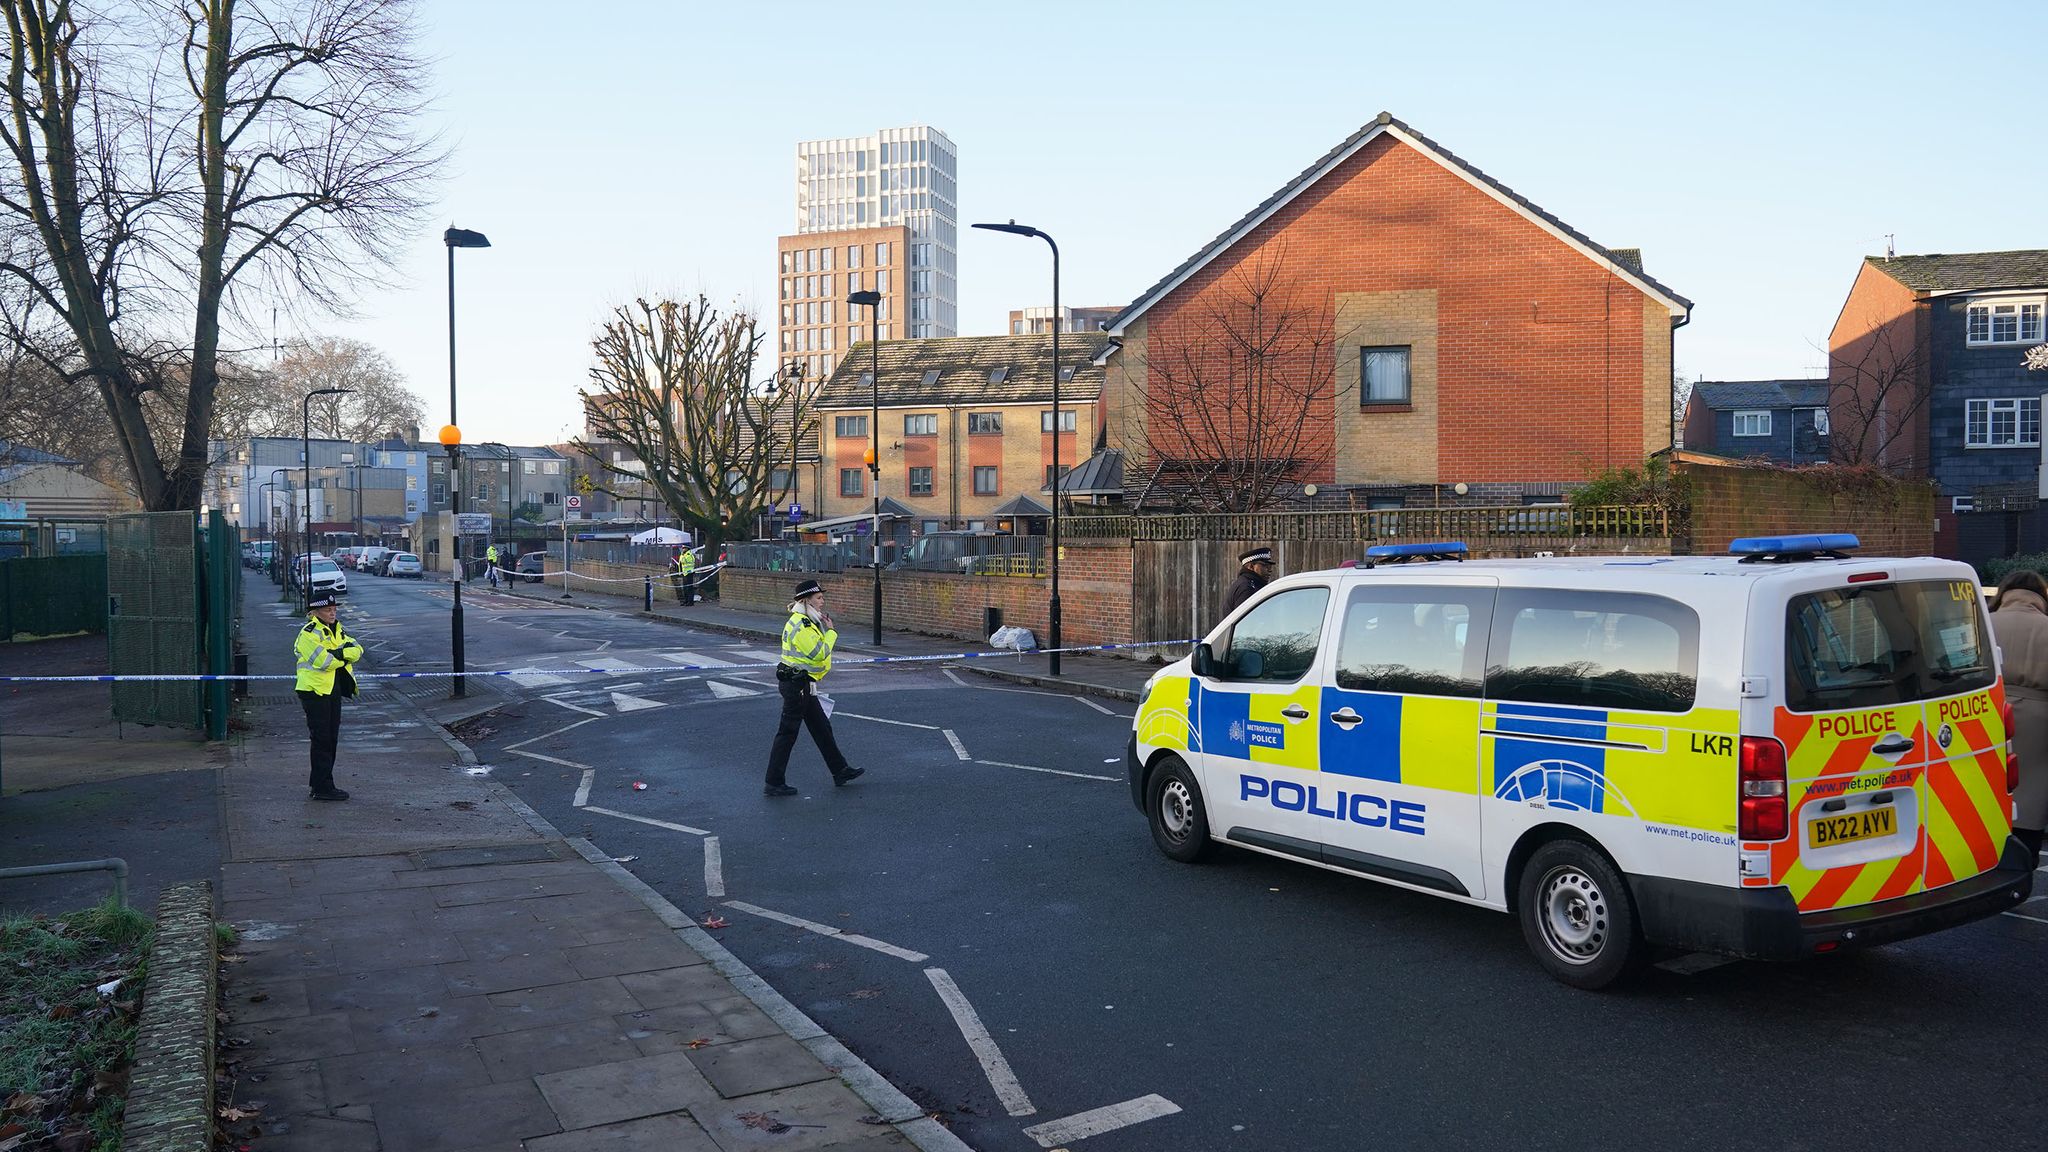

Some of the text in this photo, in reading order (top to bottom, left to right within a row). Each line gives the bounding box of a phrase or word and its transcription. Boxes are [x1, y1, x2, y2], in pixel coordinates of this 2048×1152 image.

[792, 506, 799, 515] P
[1949, 582, 1975, 601] LKR
[1939, 694, 1989, 722] POLICE
[1247, 724, 1282, 734] METROPOLITAN
[1819, 711, 1896, 738] POLICE
[1251, 734, 1277, 744] POLICE
[1691, 733, 1733, 756] LKR
[1805, 770, 1913, 795] www.met.police.uk
[1240, 774, 1426, 835] POLICE
[1645, 824, 1737, 846] www.met.police.uk
[1816, 810, 1890, 843] BX22 AYV
